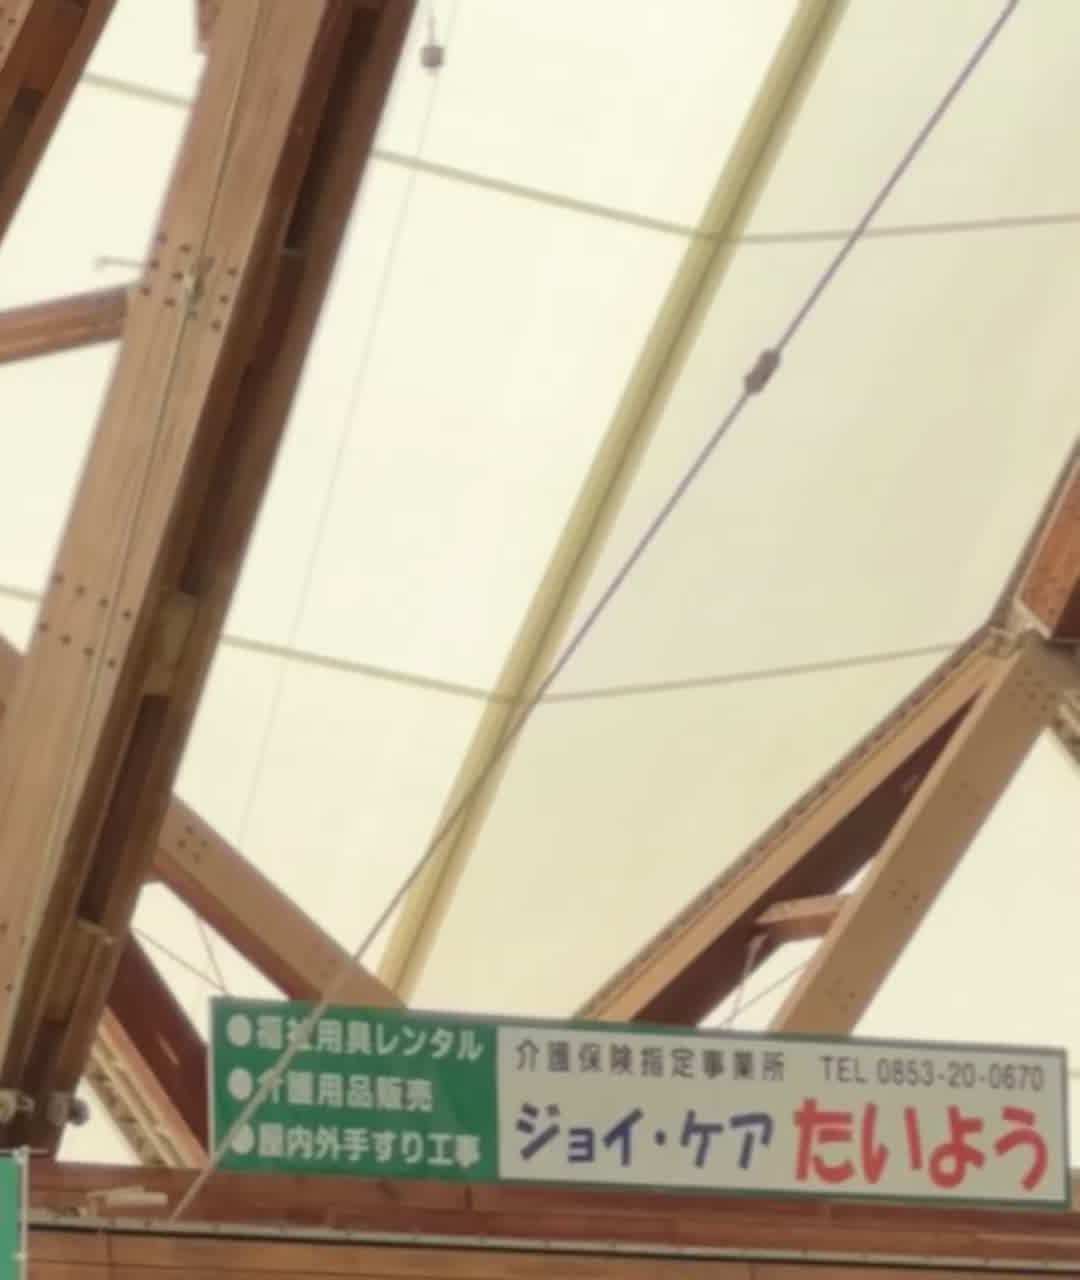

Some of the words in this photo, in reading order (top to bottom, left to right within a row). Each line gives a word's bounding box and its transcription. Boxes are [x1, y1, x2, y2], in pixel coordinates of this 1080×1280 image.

[515, 1038, 785, 1082] 介護保険指定事業所
[822, 1055, 868, 1084] TEL
[876, 1057, 1046, 1092] 0853-20-0670
[257, 1121, 481, 1169] 屋内外手すり工事
[515, 1101, 774, 1170] ジョイ・ケア
[793, 1097, 1049, 1190] たいよう
